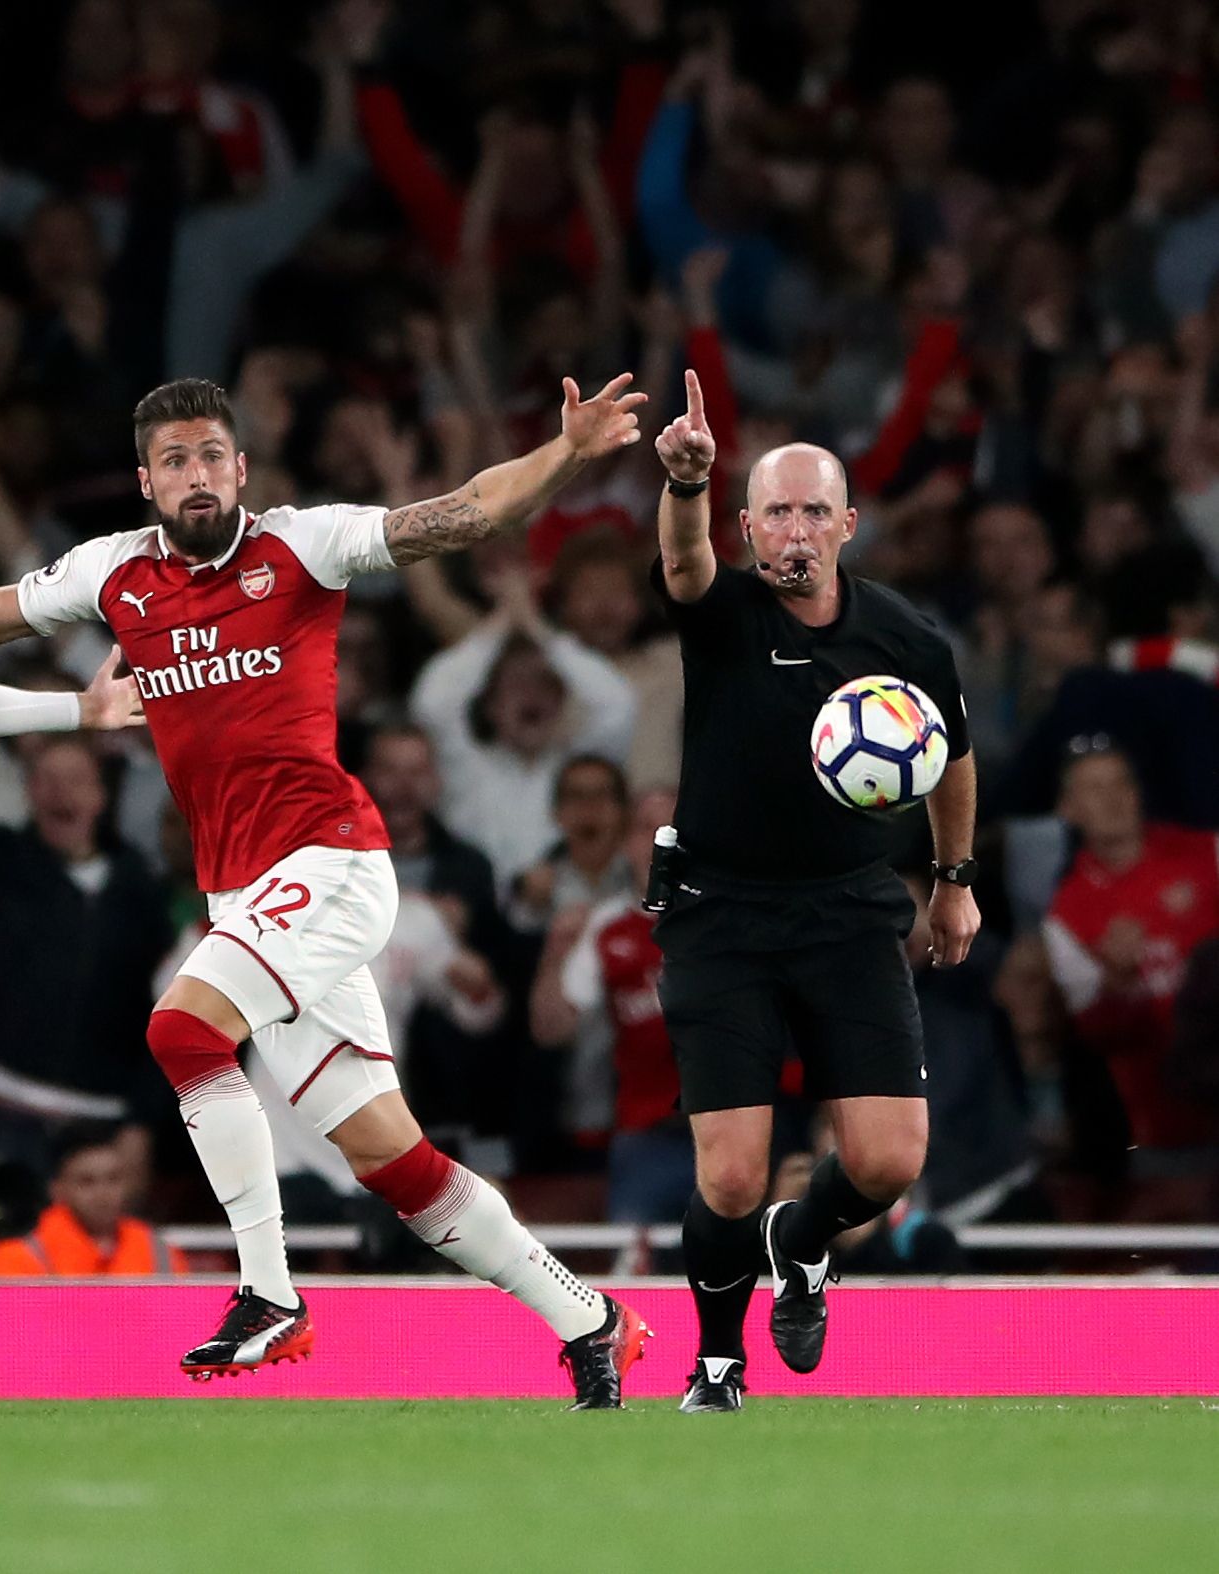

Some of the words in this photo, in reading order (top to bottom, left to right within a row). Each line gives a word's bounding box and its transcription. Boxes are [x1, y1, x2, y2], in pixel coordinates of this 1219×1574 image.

[170, 626, 218, 654] Fly
[132, 646, 282, 699] Emirates
[245, 877, 311, 931] 12
